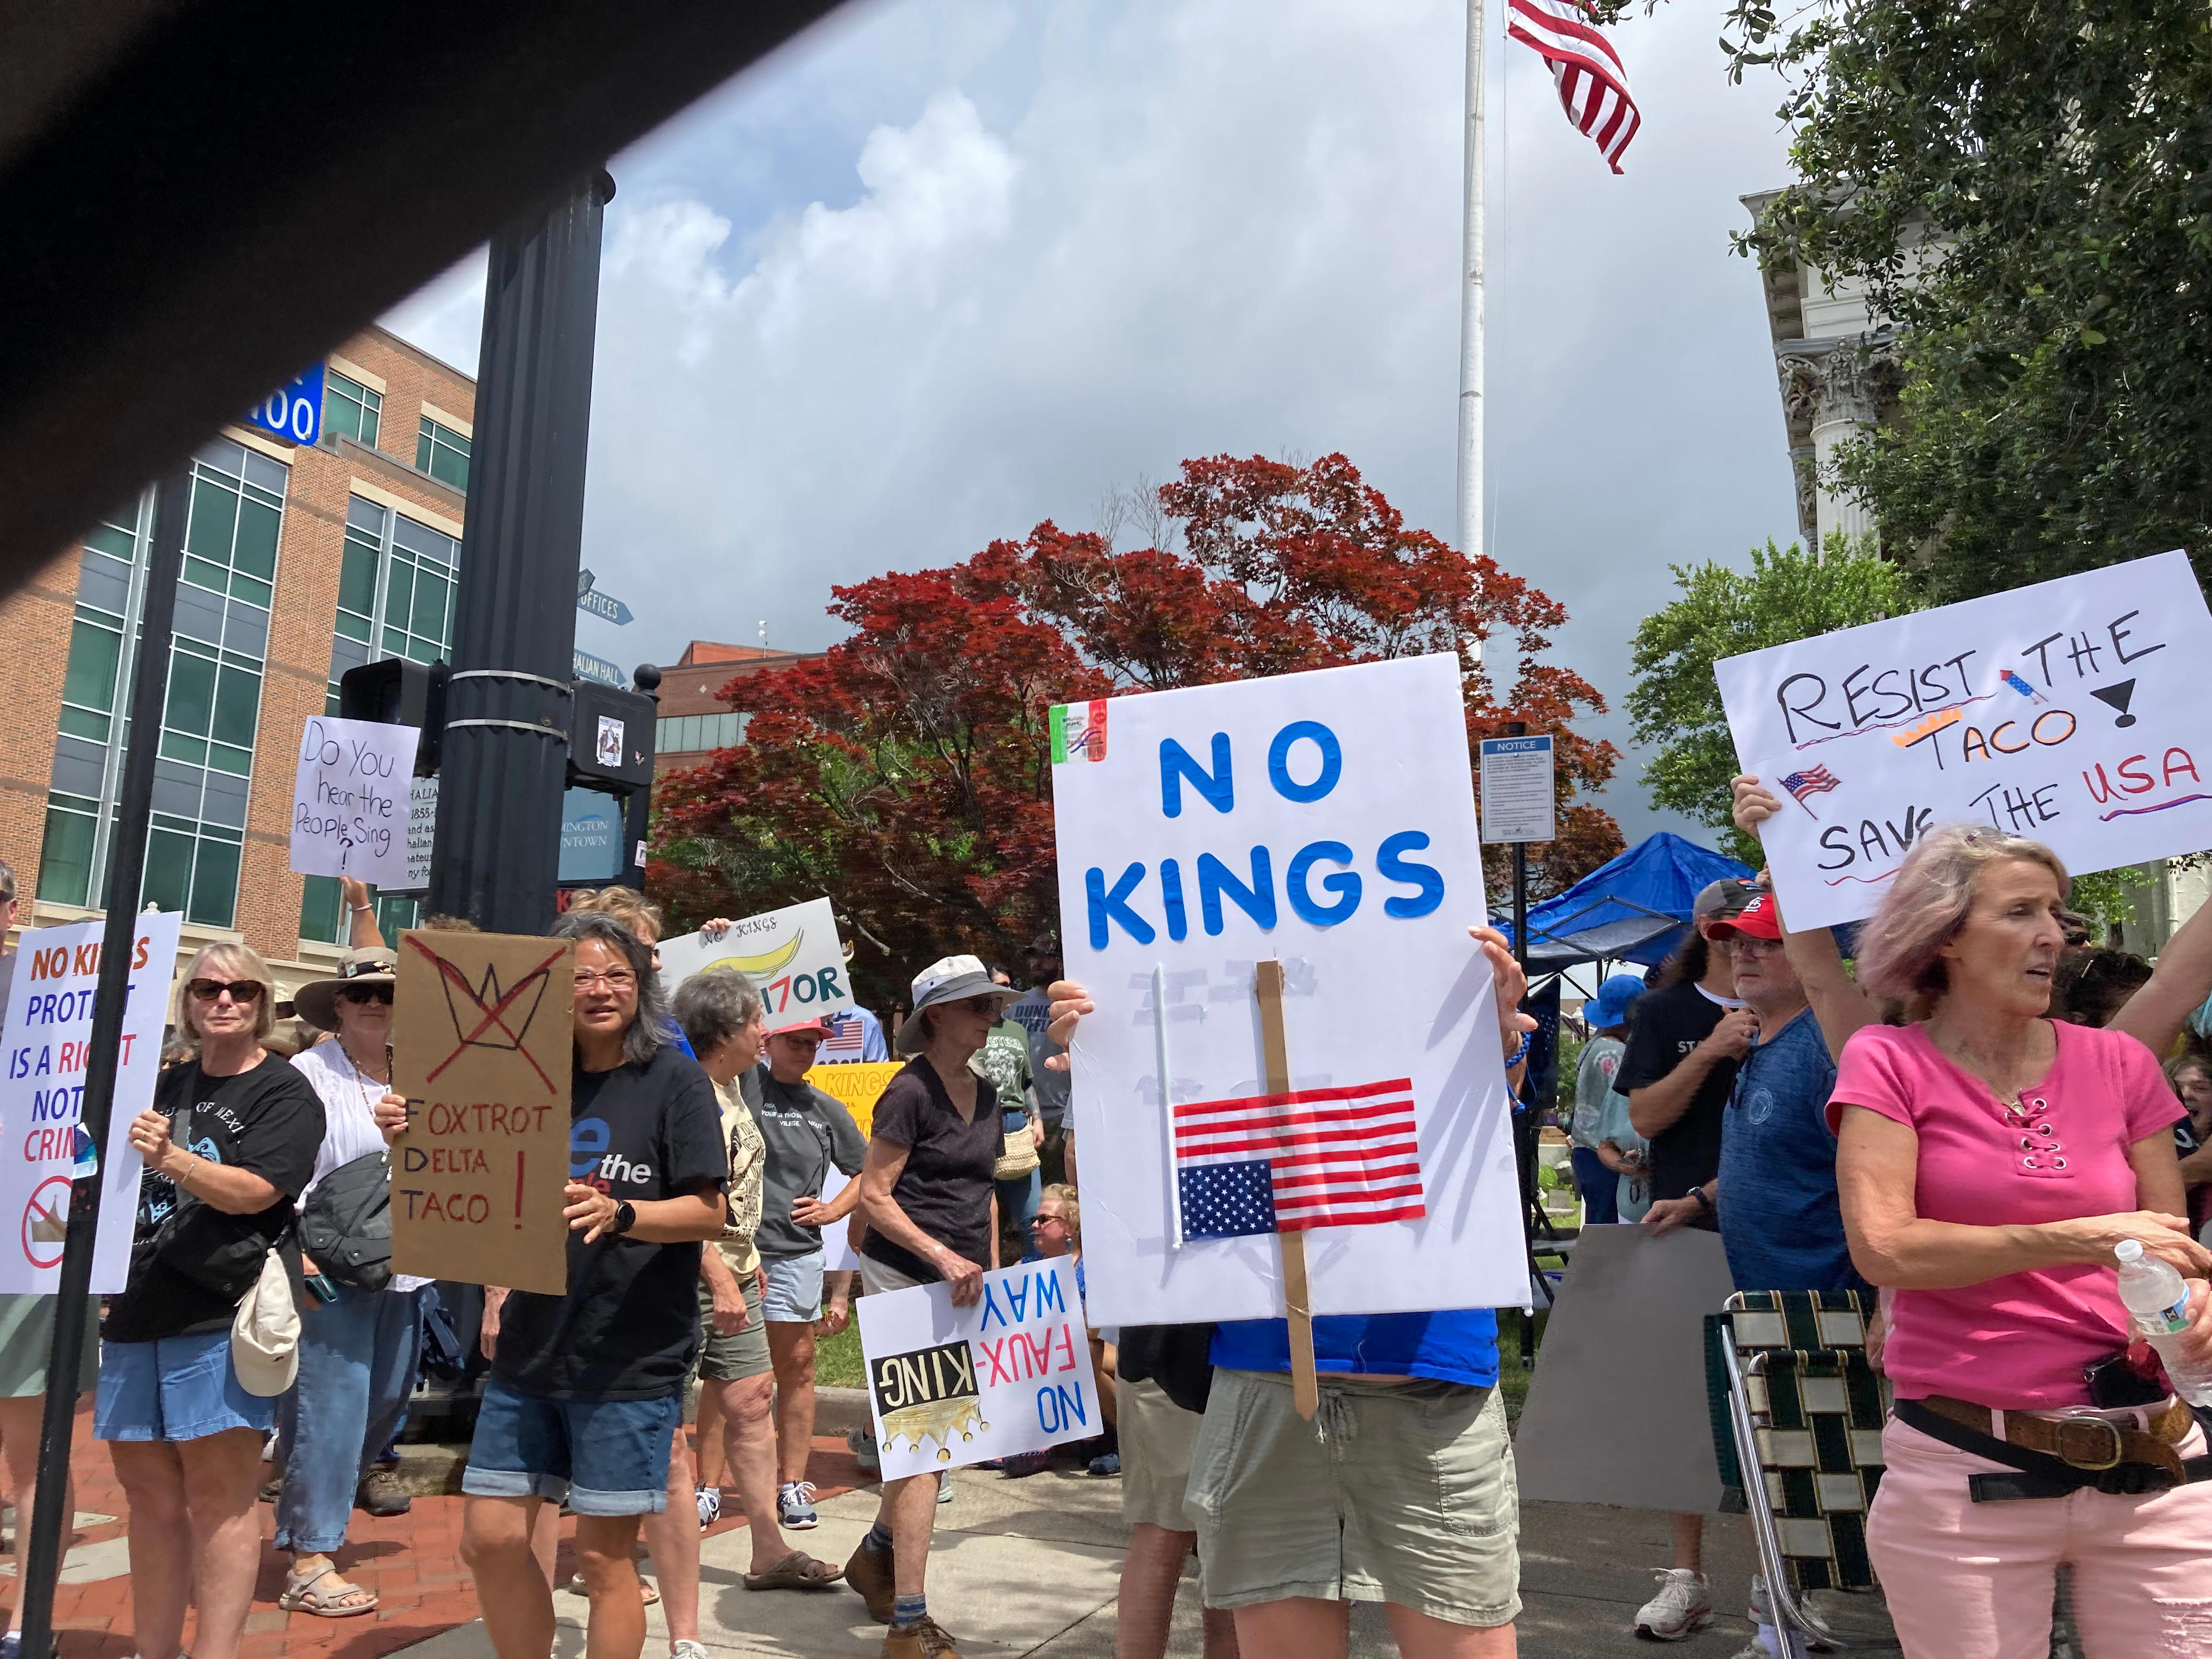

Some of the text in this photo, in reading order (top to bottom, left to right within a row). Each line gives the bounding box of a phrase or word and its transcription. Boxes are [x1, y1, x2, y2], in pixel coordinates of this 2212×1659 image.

[581, 592, 618, 619] OFFICES
[573, 653, 619, 685] HALIAN HALL
[1777, 610, 2166, 743] RESIST THE
[1497, 741, 1536, 751] NOTICE
[1905, 710, 2076, 770] TACO
[1160, 720, 1342, 818] NO
[317, 770, 392, 817] hear the
[1969, 783, 2060, 832] THE
[2083, 747, 2201, 806] USA
[411, 807, 436, 819] 1855-
[354, 817, 391, 857] Sing
[561, 836, 607, 847] NTOWN
[421, 866, 430, 876] fo
[1085, 831, 1445, 950] KINGS
[705, 917, 777, 946] NO KINGS
[30, 936, 150, 981] NO KIS
[26, 985, 136, 1026] PROTT
[9, 1034, 137, 1079] IS A RIT
[32, 1086, 85, 1122] NOT
[196, 1102, 215, 1113] OF
[214, 1107, 245, 1133] MEXI
[406, 1099, 552, 1136] FOXTROT
[24, 1127, 74, 1161] CRI
[404, 1147, 490, 1173] DELTA
[570, 1117, 610, 1178] e
[599, 1154, 652, 1184] the
[399, 1190, 489, 1223] TACO
[980, 1269, 1066, 1332] WAY
[879, 1323, 1076, 1407] FAUX- KING
[1037, 1381, 1086, 1434] NO
